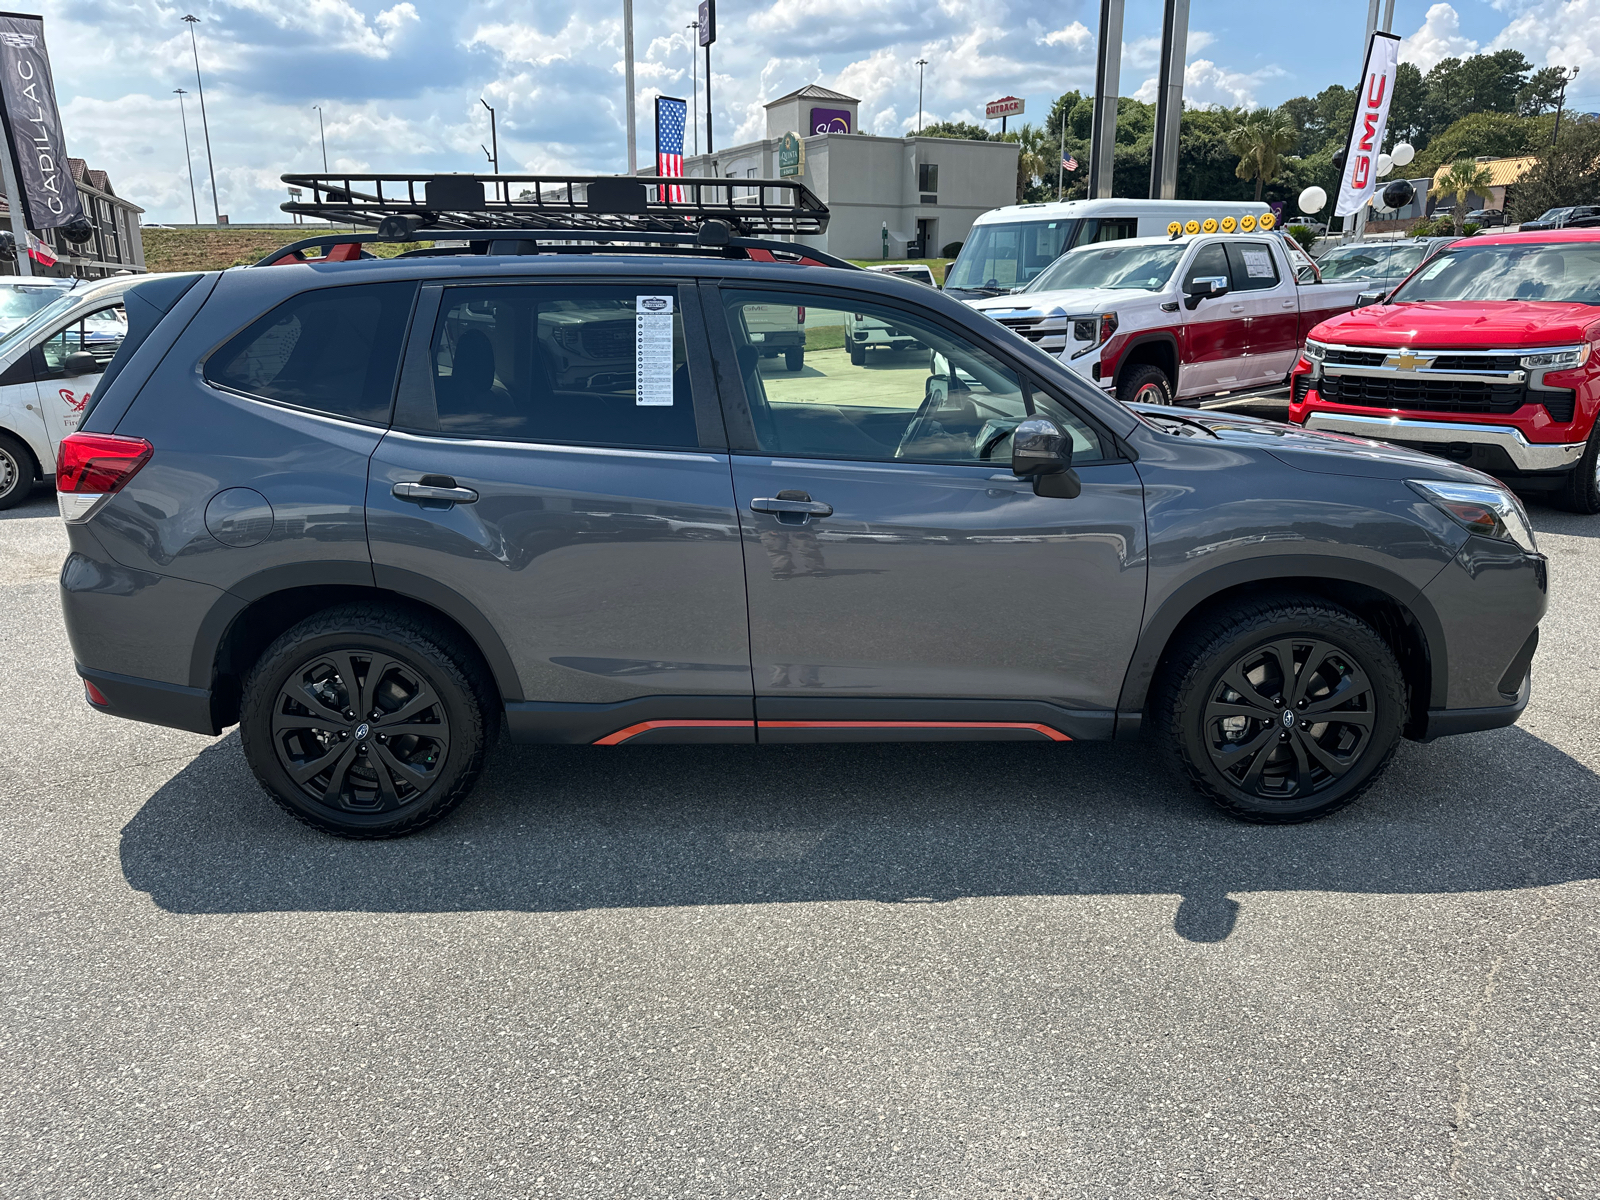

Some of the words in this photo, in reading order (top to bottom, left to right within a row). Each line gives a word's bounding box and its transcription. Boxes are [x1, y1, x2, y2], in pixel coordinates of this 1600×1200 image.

[18, 60, 64, 214] CADILLAC
[986, 102, 1019, 115] OUTBACK
[1351, 73, 1387, 190] GMC
[781, 150, 798, 162] QUINTA
